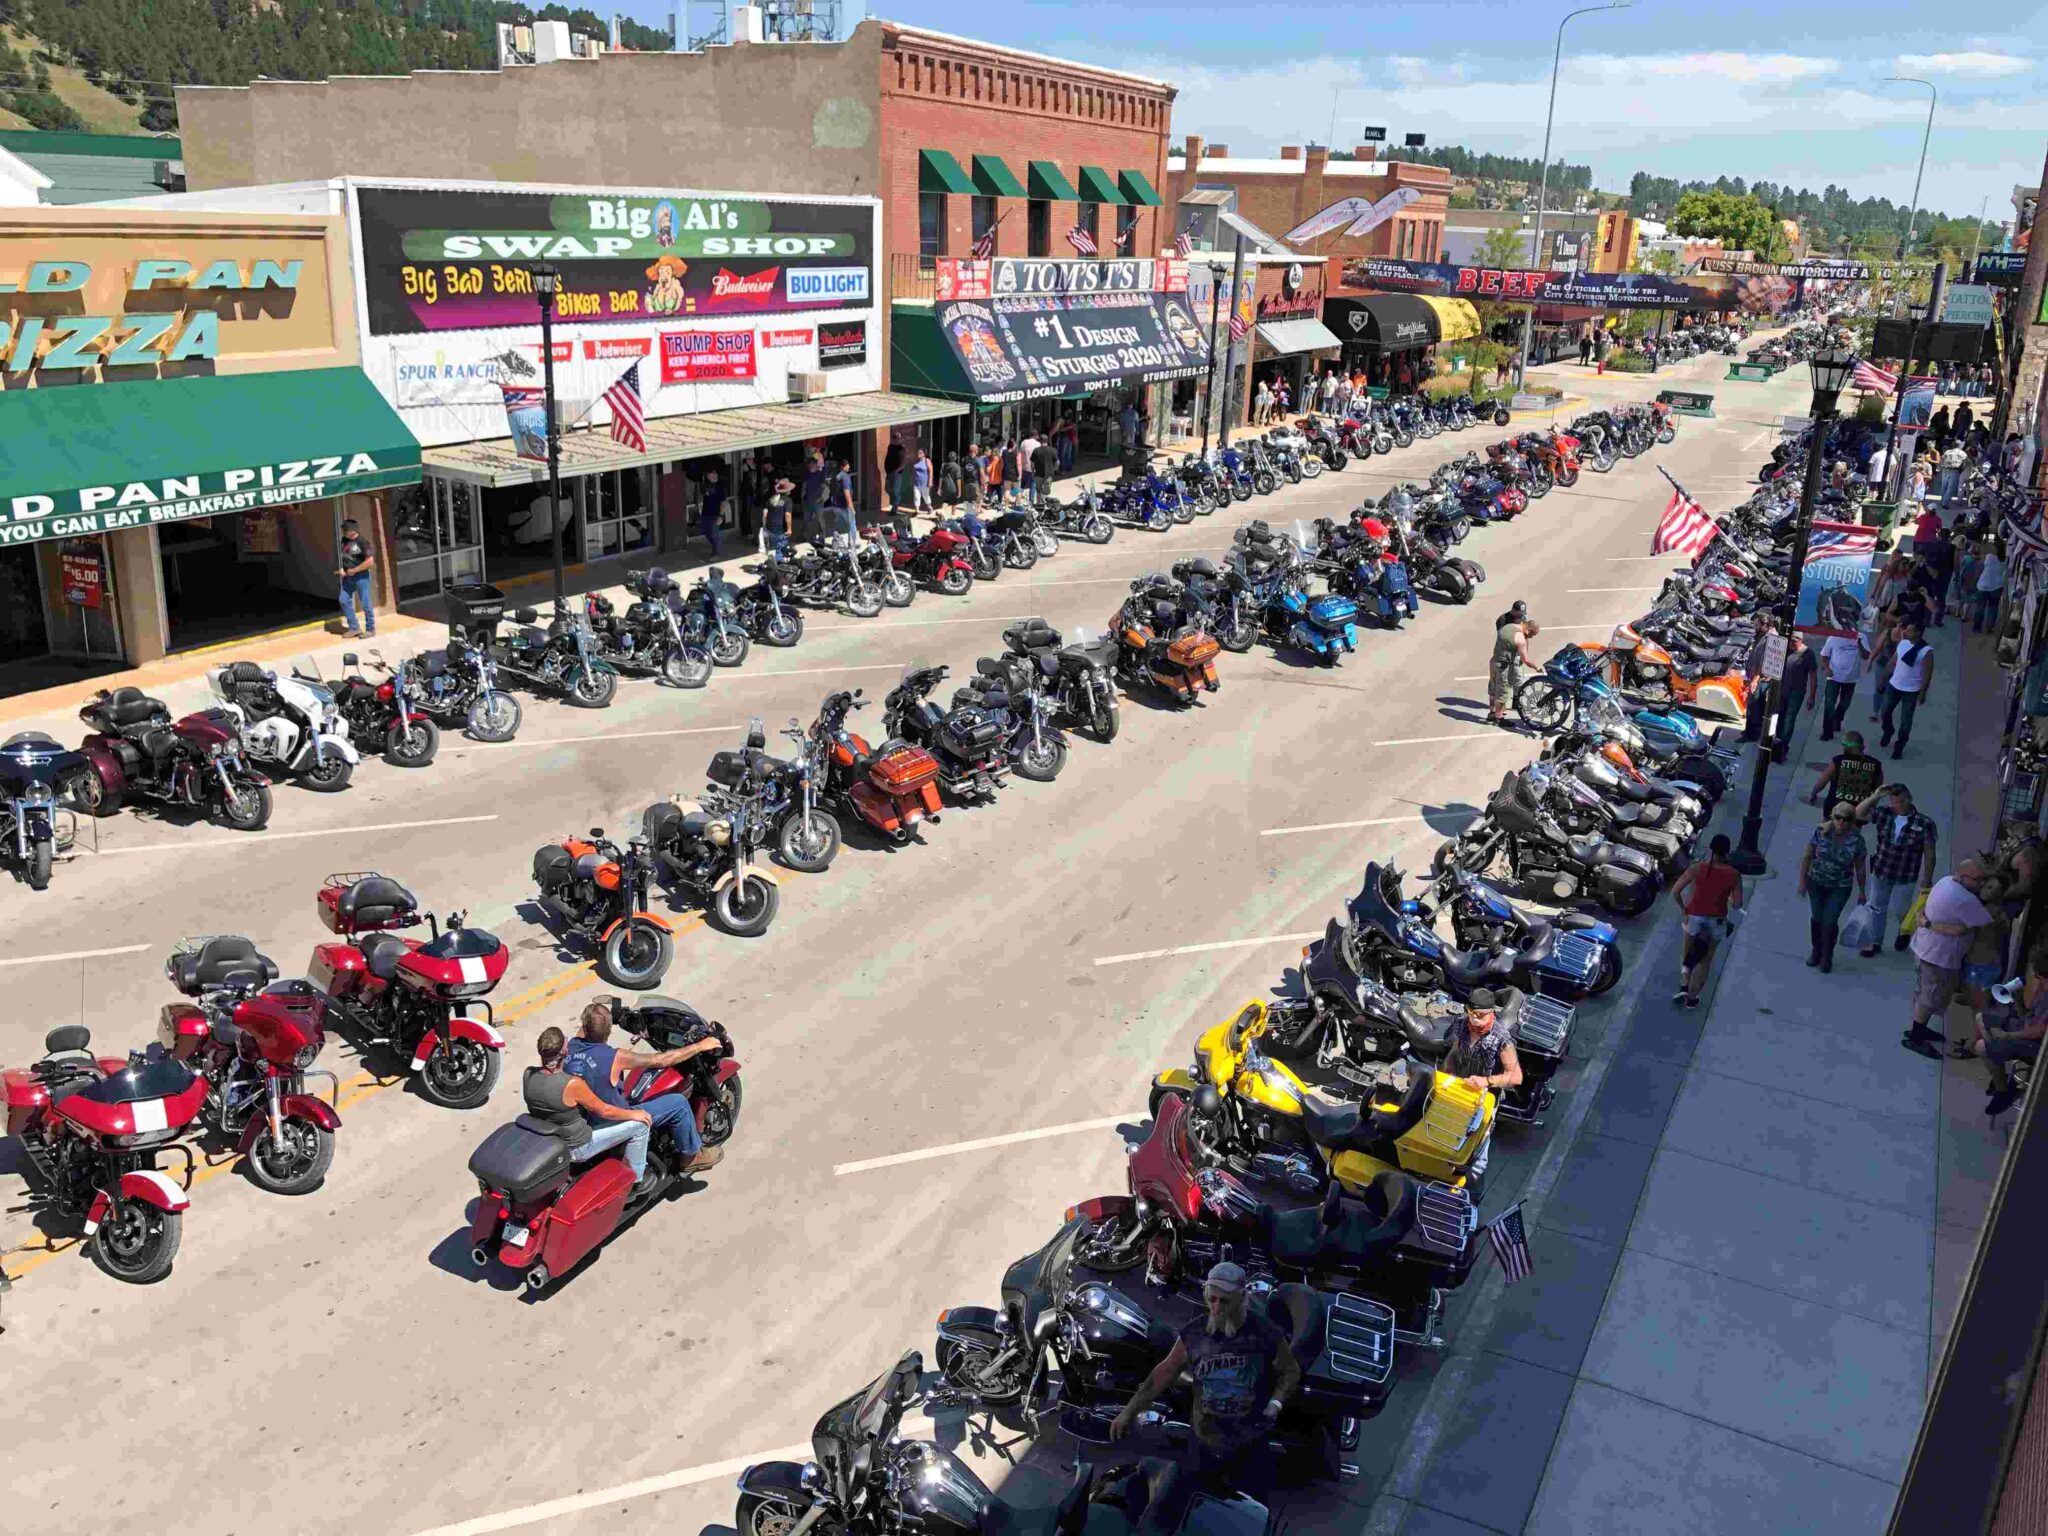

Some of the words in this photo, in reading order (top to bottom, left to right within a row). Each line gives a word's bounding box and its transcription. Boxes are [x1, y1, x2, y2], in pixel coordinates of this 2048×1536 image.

[587, 200, 651, 238] Big
[683, 203, 739, 230] Al's
[443, 235, 633, 258] SWAP
[702, 236, 837, 256] SHOP
[131, 259, 305, 291] PAN
[1023, 262, 1100, 292] TOM'S
[1103, 261, 1135, 290] T'S
[1358, 262, 1382, 271] GREAT
[1369, 270, 1392, 278] GREAT
[1736, 260, 1779, 275] BROWN
[1780, 266, 1858, 279] MOTORCYCLE
[712, 275, 774, 296] Budweiser
[791, 276, 822, 294] BUD
[824, 274, 864, 293] LIGHT
[1456, 268, 1546, 297] BEEF
[1545, 282, 1561, 291] THE
[1603, 285, 1626, 294] MEAT
[1544, 290, 1563, 299] CITY
[1576, 292, 1607, 301] STURGIS
[1608, 293, 1662, 303] MOTORCYCLE
[1663, 295, 1690, 304] RALLY
[770, 330, 807, 347] Budweiser
[1033, 314, 1075, 349] #1
[1072, 326, 1141, 347] DESIGN
[594, 341, 644, 358] Budweiser
[665, 335, 712, 353] TRUMP
[717, 333, 752, 351] SHOP
[668, 355, 690, 368] KEEP
[691, 353, 727, 366] AMERICA
[728, 352, 750, 364] FIRST
[1042, 353, 1120, 378] STURGIS
[1117, 345, 1162, 368] 2020
[399, 364, 437, 381] SPUR
[444, 363, 496, 379] RANCH
[695, 366, 726, 378] 2020
[970, 361, 1017, 382] STURGIS
[981, 389, 1025, 403] PRINTED
[1026, 384, 1067, 399] LOCALLY
[1084, 380, 1109, 392] TOM'S
[1110, 378, 1122, 388] T'S
[1143, 365, 1213, 383] STURGISTEES.CO
[79, 475, 200, 512] PAN
[223, 452, 378, 492] PIZZA
[0, 522, 44, 543] YOU
[52, 515, 98, 535] CAN
[104, 509, 142, 529] EAT
[149, 492, 257, 521] BREAKFAST
[262, 482, 325, 505] BUFFET
[1806, 562, 1867, 585] STURGIS
